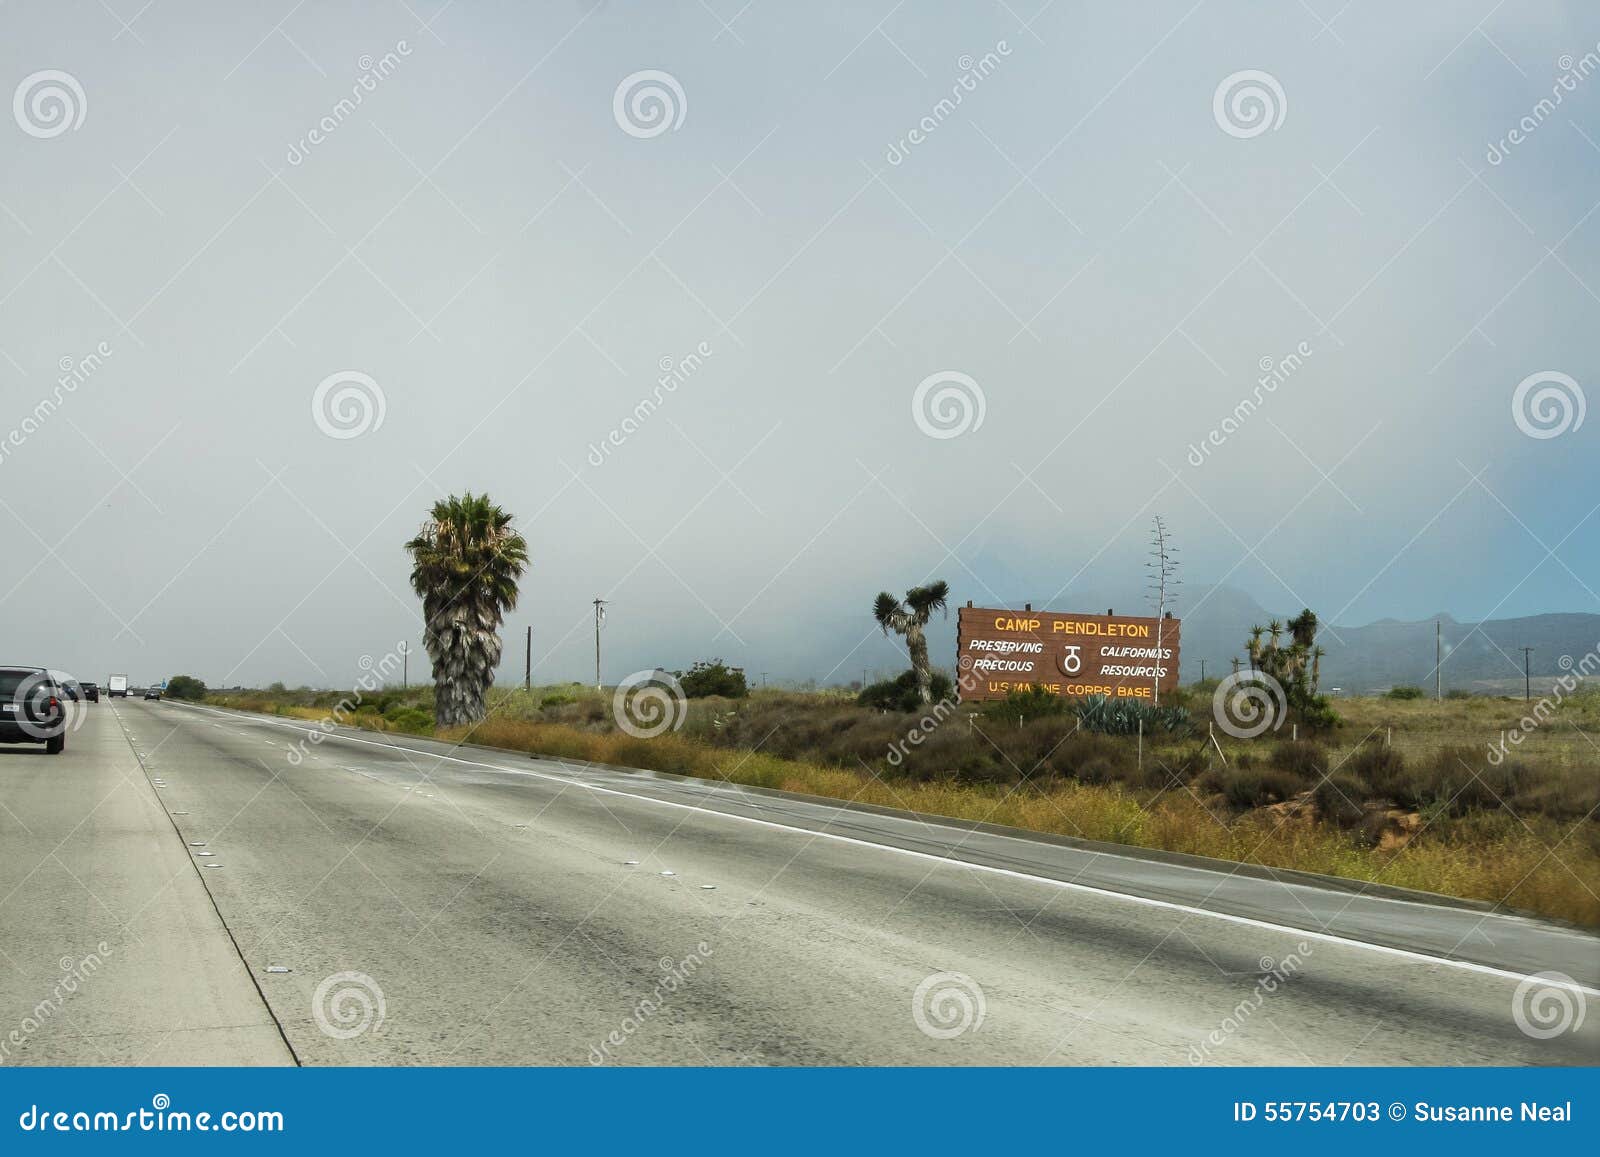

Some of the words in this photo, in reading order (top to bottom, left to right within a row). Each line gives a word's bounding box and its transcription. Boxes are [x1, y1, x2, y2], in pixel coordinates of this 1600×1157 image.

[995, 617, 1041, 632] CAMP
[1053, 621, 1149, 637] PENDLETON
[969, 639, 1043, 653] PRESERVING
[1100, 646, 1172, 659] CALIFORNIA'S
[973, 659, 1034, 671] PRECIOUS
[1100, 665, 1168, 677] RESOURCES
[1067, 685, 1112, 696] CORPS
[1117, 687, 1151, 697] BASE
